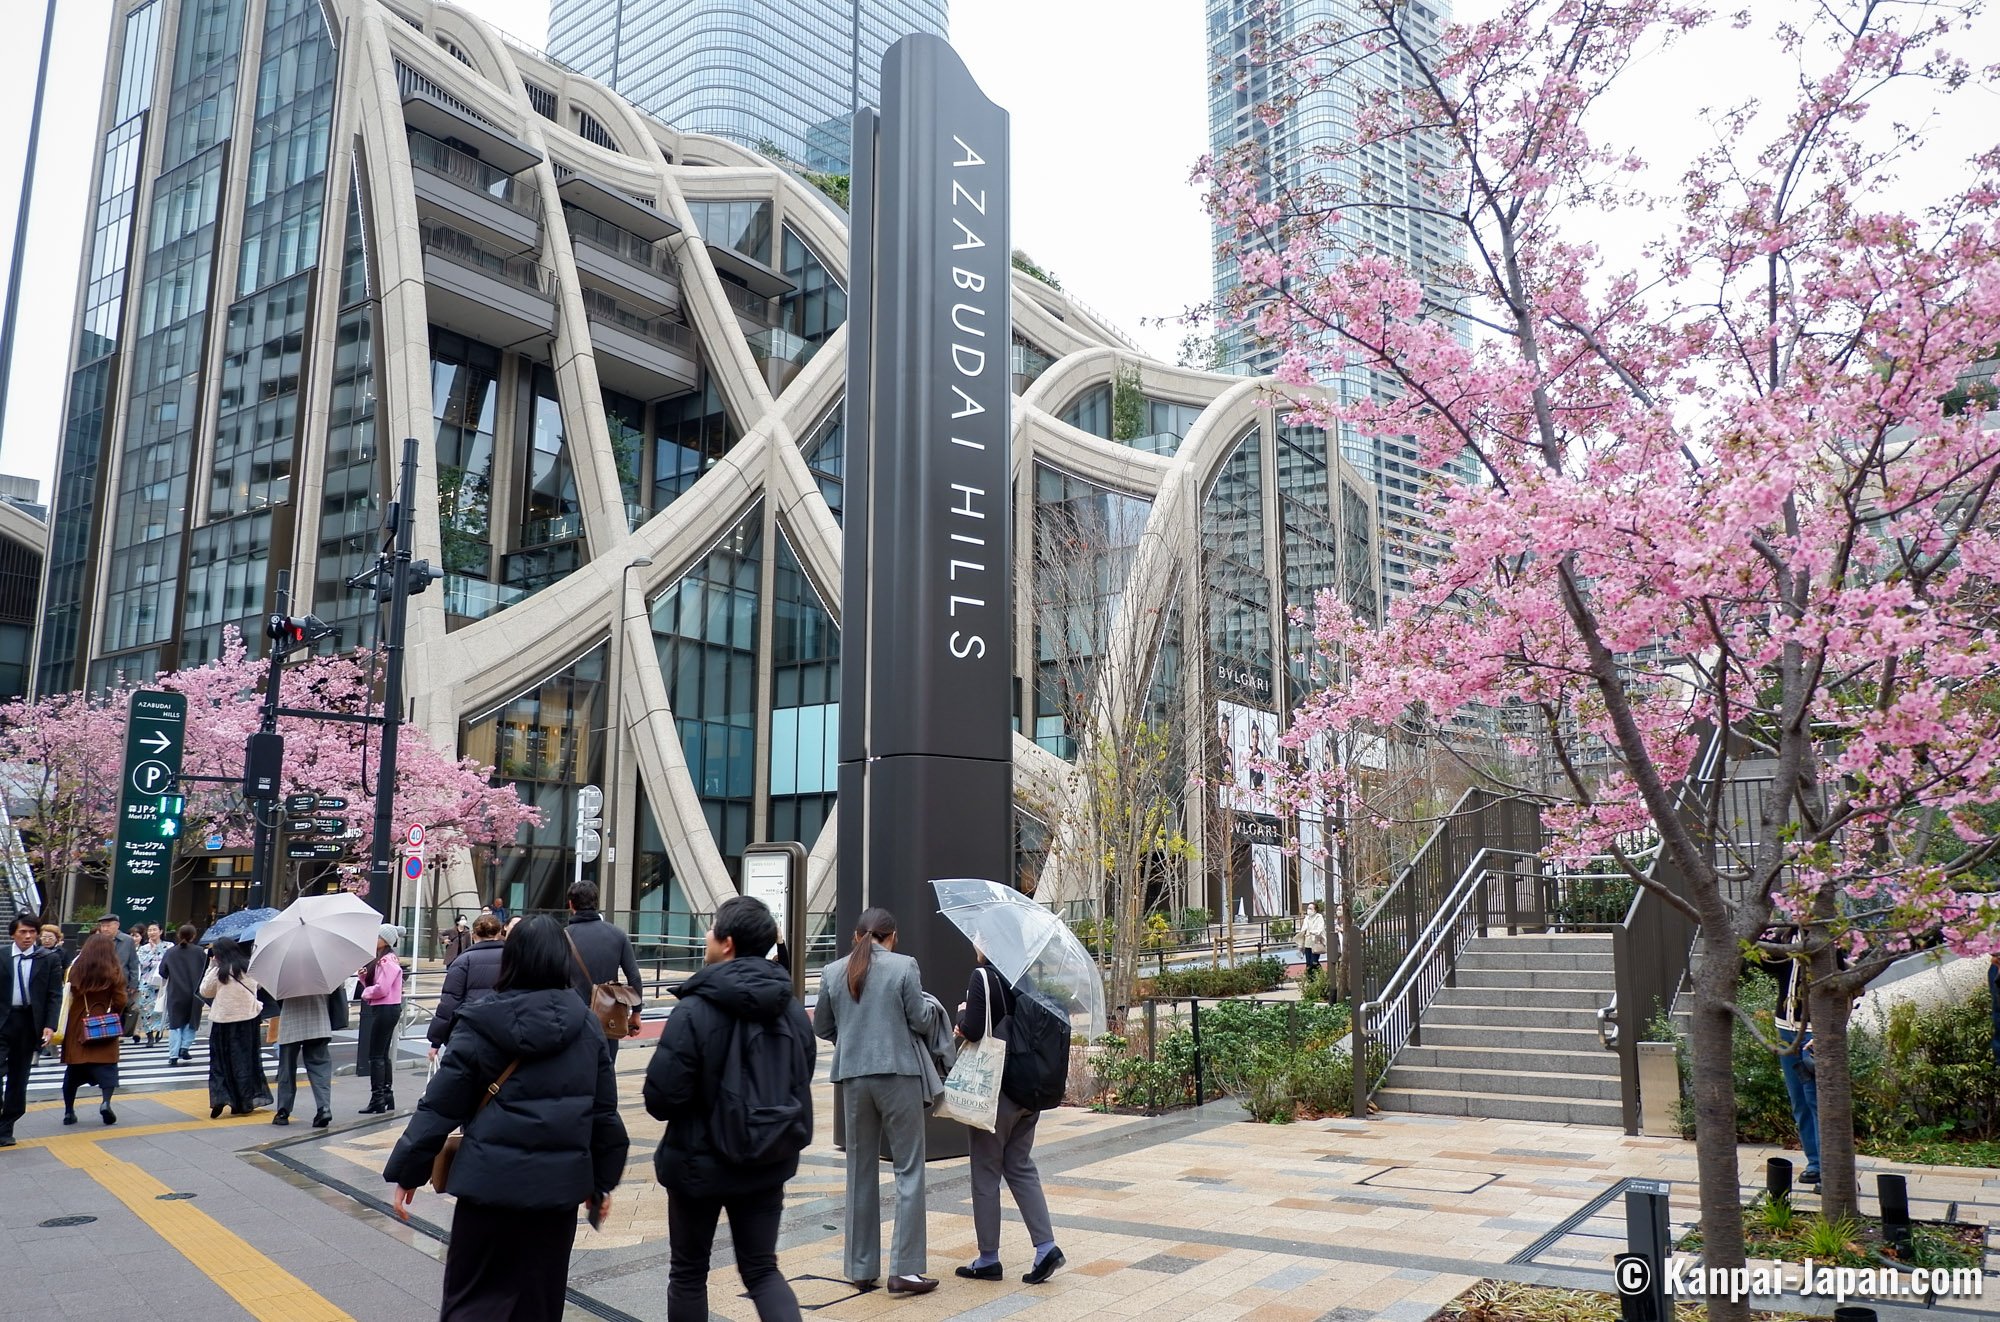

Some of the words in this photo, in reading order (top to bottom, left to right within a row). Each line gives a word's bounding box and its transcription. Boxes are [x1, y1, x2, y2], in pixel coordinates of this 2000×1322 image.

[951, 134, 986, 450] AZABUDAI
[949, 483, 986, 659] HILLS
[1218, 665, 1269, 692] BVLGARI
[138, 701, 171, 709] AZABUDAI
[146, 766, 161, 789] P
[128, 804, 158, 813] 森JPタ
[411, 830, 421, 840] 40
[125, 841, 166, 850] ミュージアム
[127, 859, 161, 868] ギャラリー
[126, 896, 155, 905] ショップ
[944, 1092, 960, 1102] UNT
[961, 1098, 989, 1109] BOOKS
